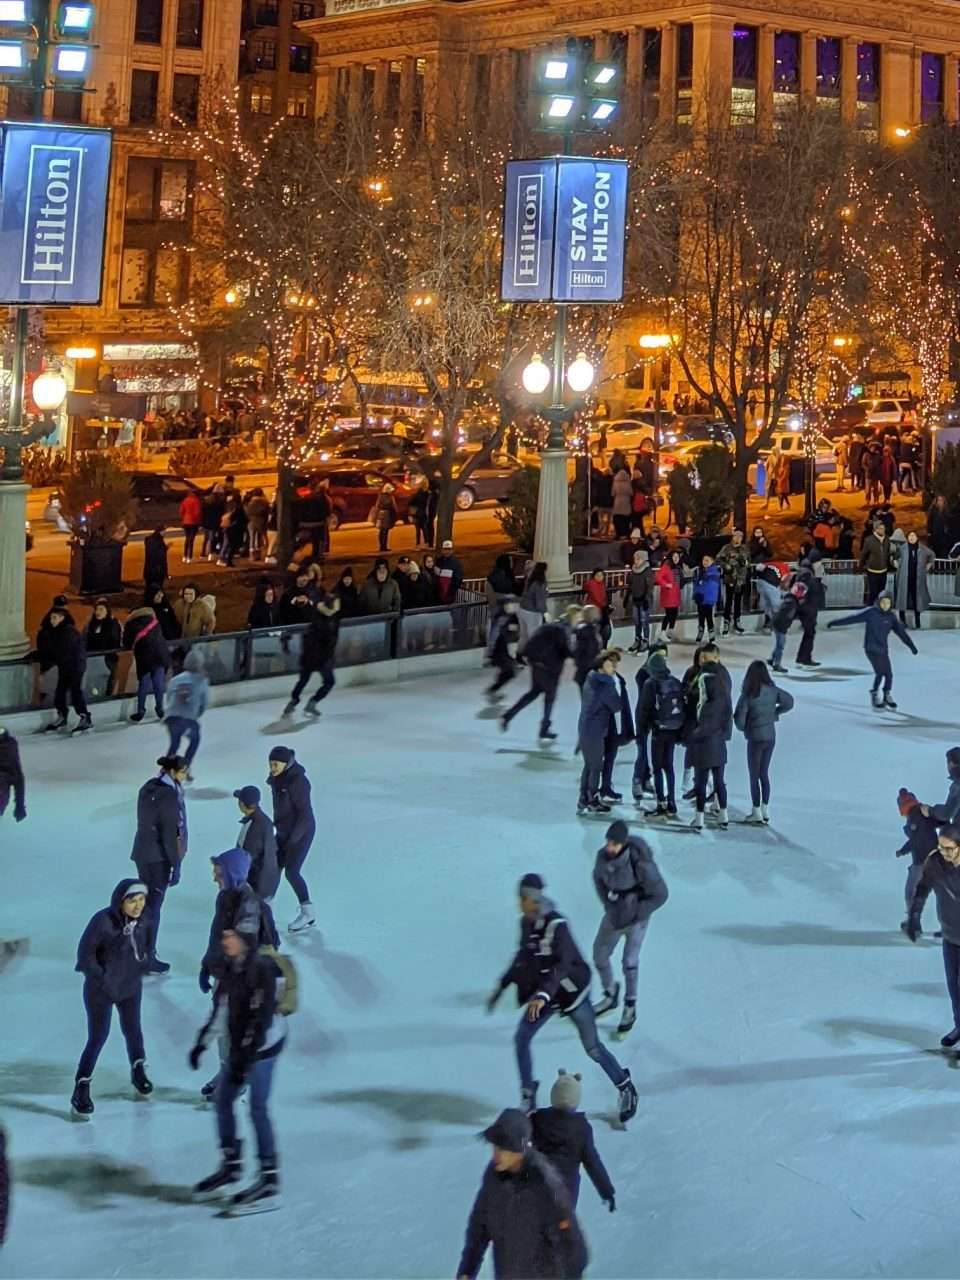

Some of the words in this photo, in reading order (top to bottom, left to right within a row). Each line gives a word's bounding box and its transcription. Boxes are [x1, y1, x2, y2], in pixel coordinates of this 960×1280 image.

[33, 158, 71, 272] Hilton
[519, 183, 538, 276] Hilton
[571, 196, 588, 261] STAY
[592, 172, 611, 262] HILTON
[573, 272, 604, 284] Hilton
